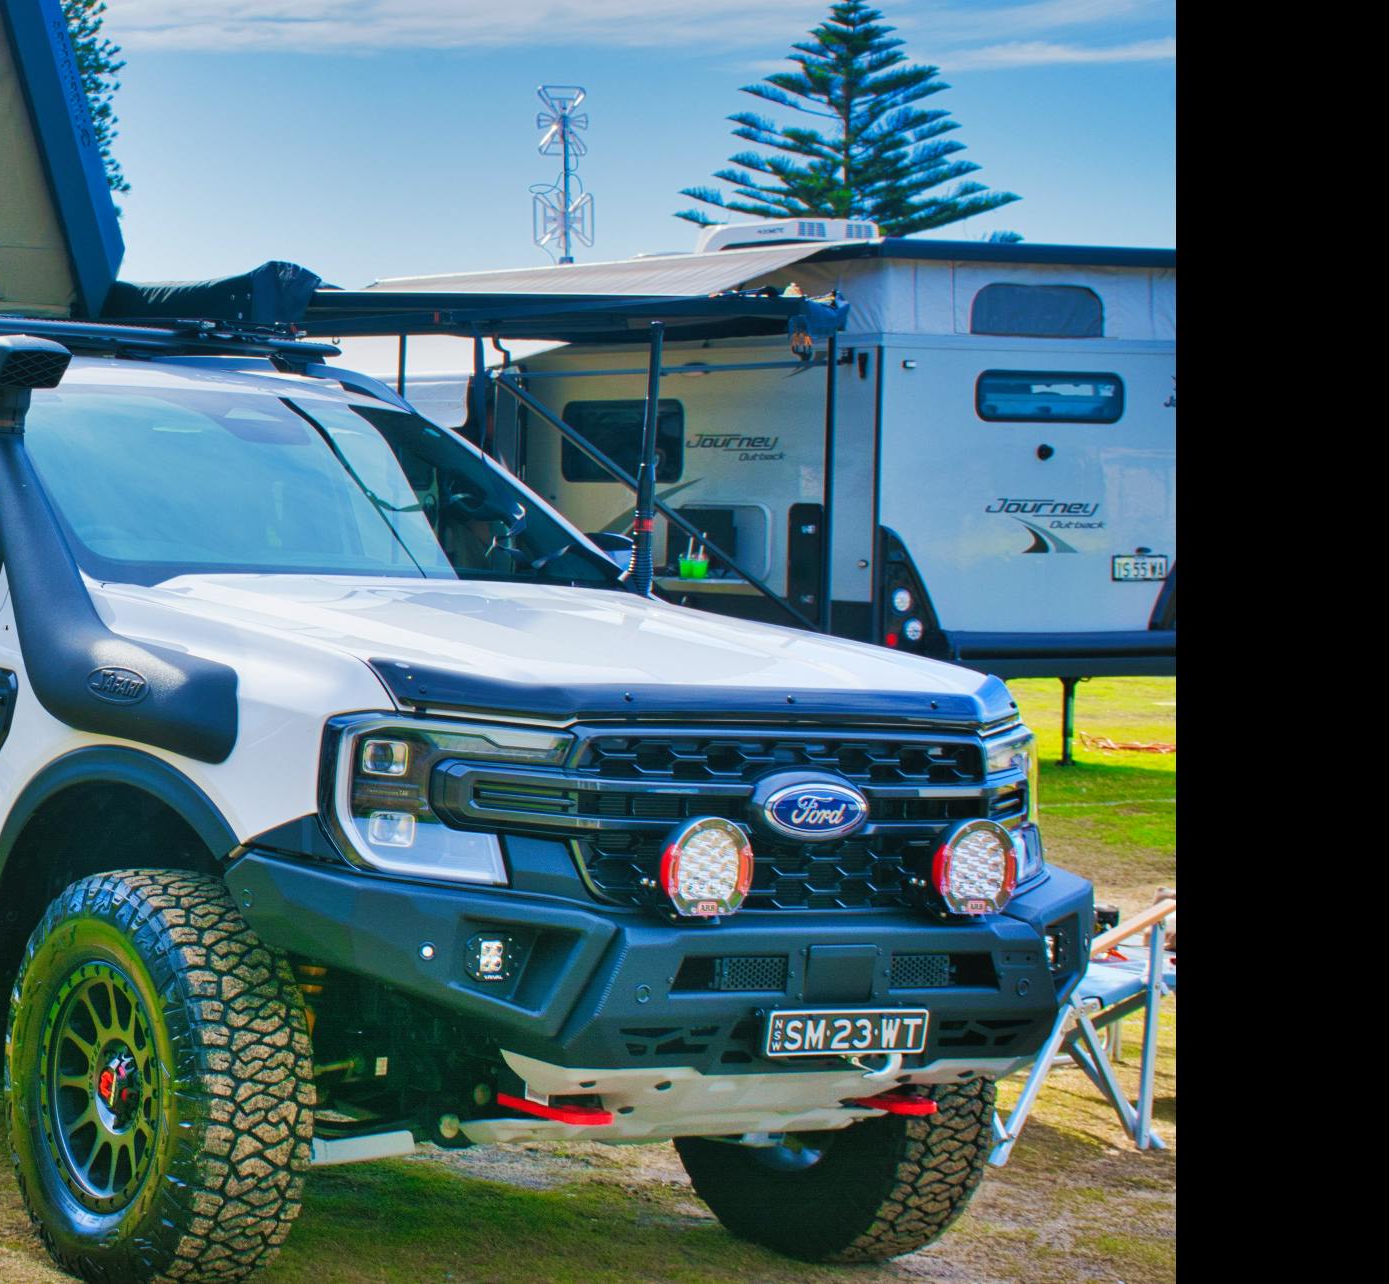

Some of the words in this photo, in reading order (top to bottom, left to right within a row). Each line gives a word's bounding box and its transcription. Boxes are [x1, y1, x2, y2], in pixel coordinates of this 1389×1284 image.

[685, 434, 779, 451] Journey
[738, 452, 786, 461] Outback
[985, 498, 1099, 517] Journey
[1049, 520, 1105, 529] Outback
[791, 795, 847, 825] Ford
